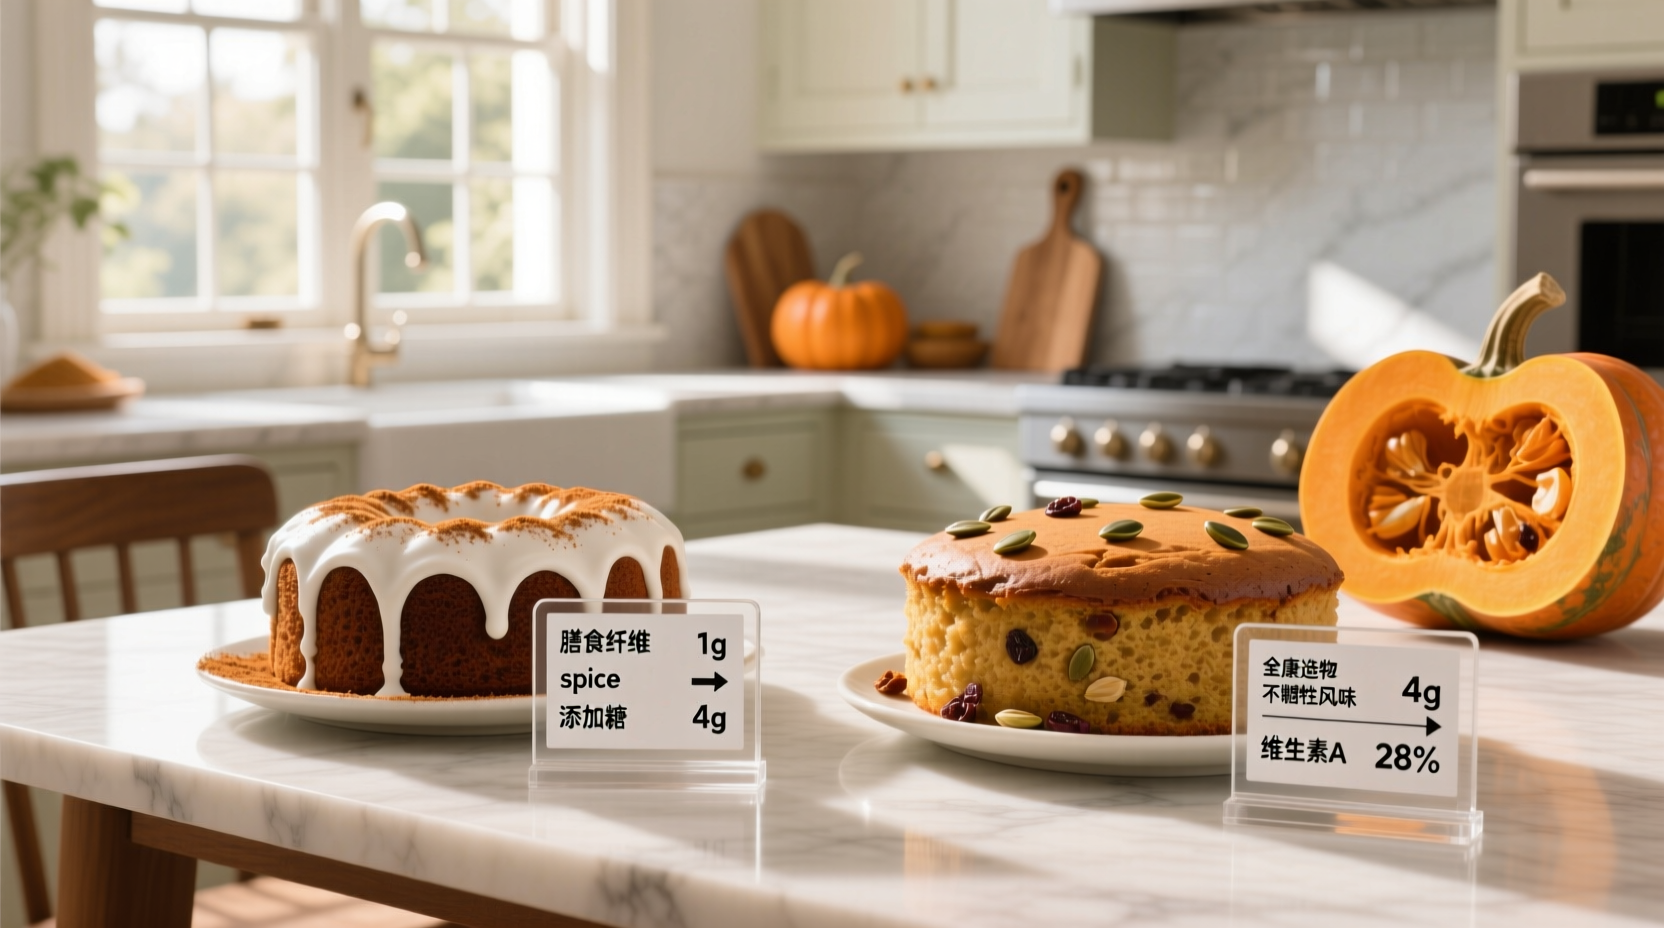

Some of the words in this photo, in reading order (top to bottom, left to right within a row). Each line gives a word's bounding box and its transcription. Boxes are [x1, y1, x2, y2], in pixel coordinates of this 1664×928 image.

[560, 628, 651, 654] 膳食纤维
[697, 631, 727, 662] 1g
[560, 667, 621, 695] spice
[1401, 675, 1441, 711] 4g
[559, 704, 628, 730] 添加糖
[692, 704, 727, 735] 4g
[1260, 734, 1347, 765] 维生素A
[1374, 742, 1440, 774] 28%
